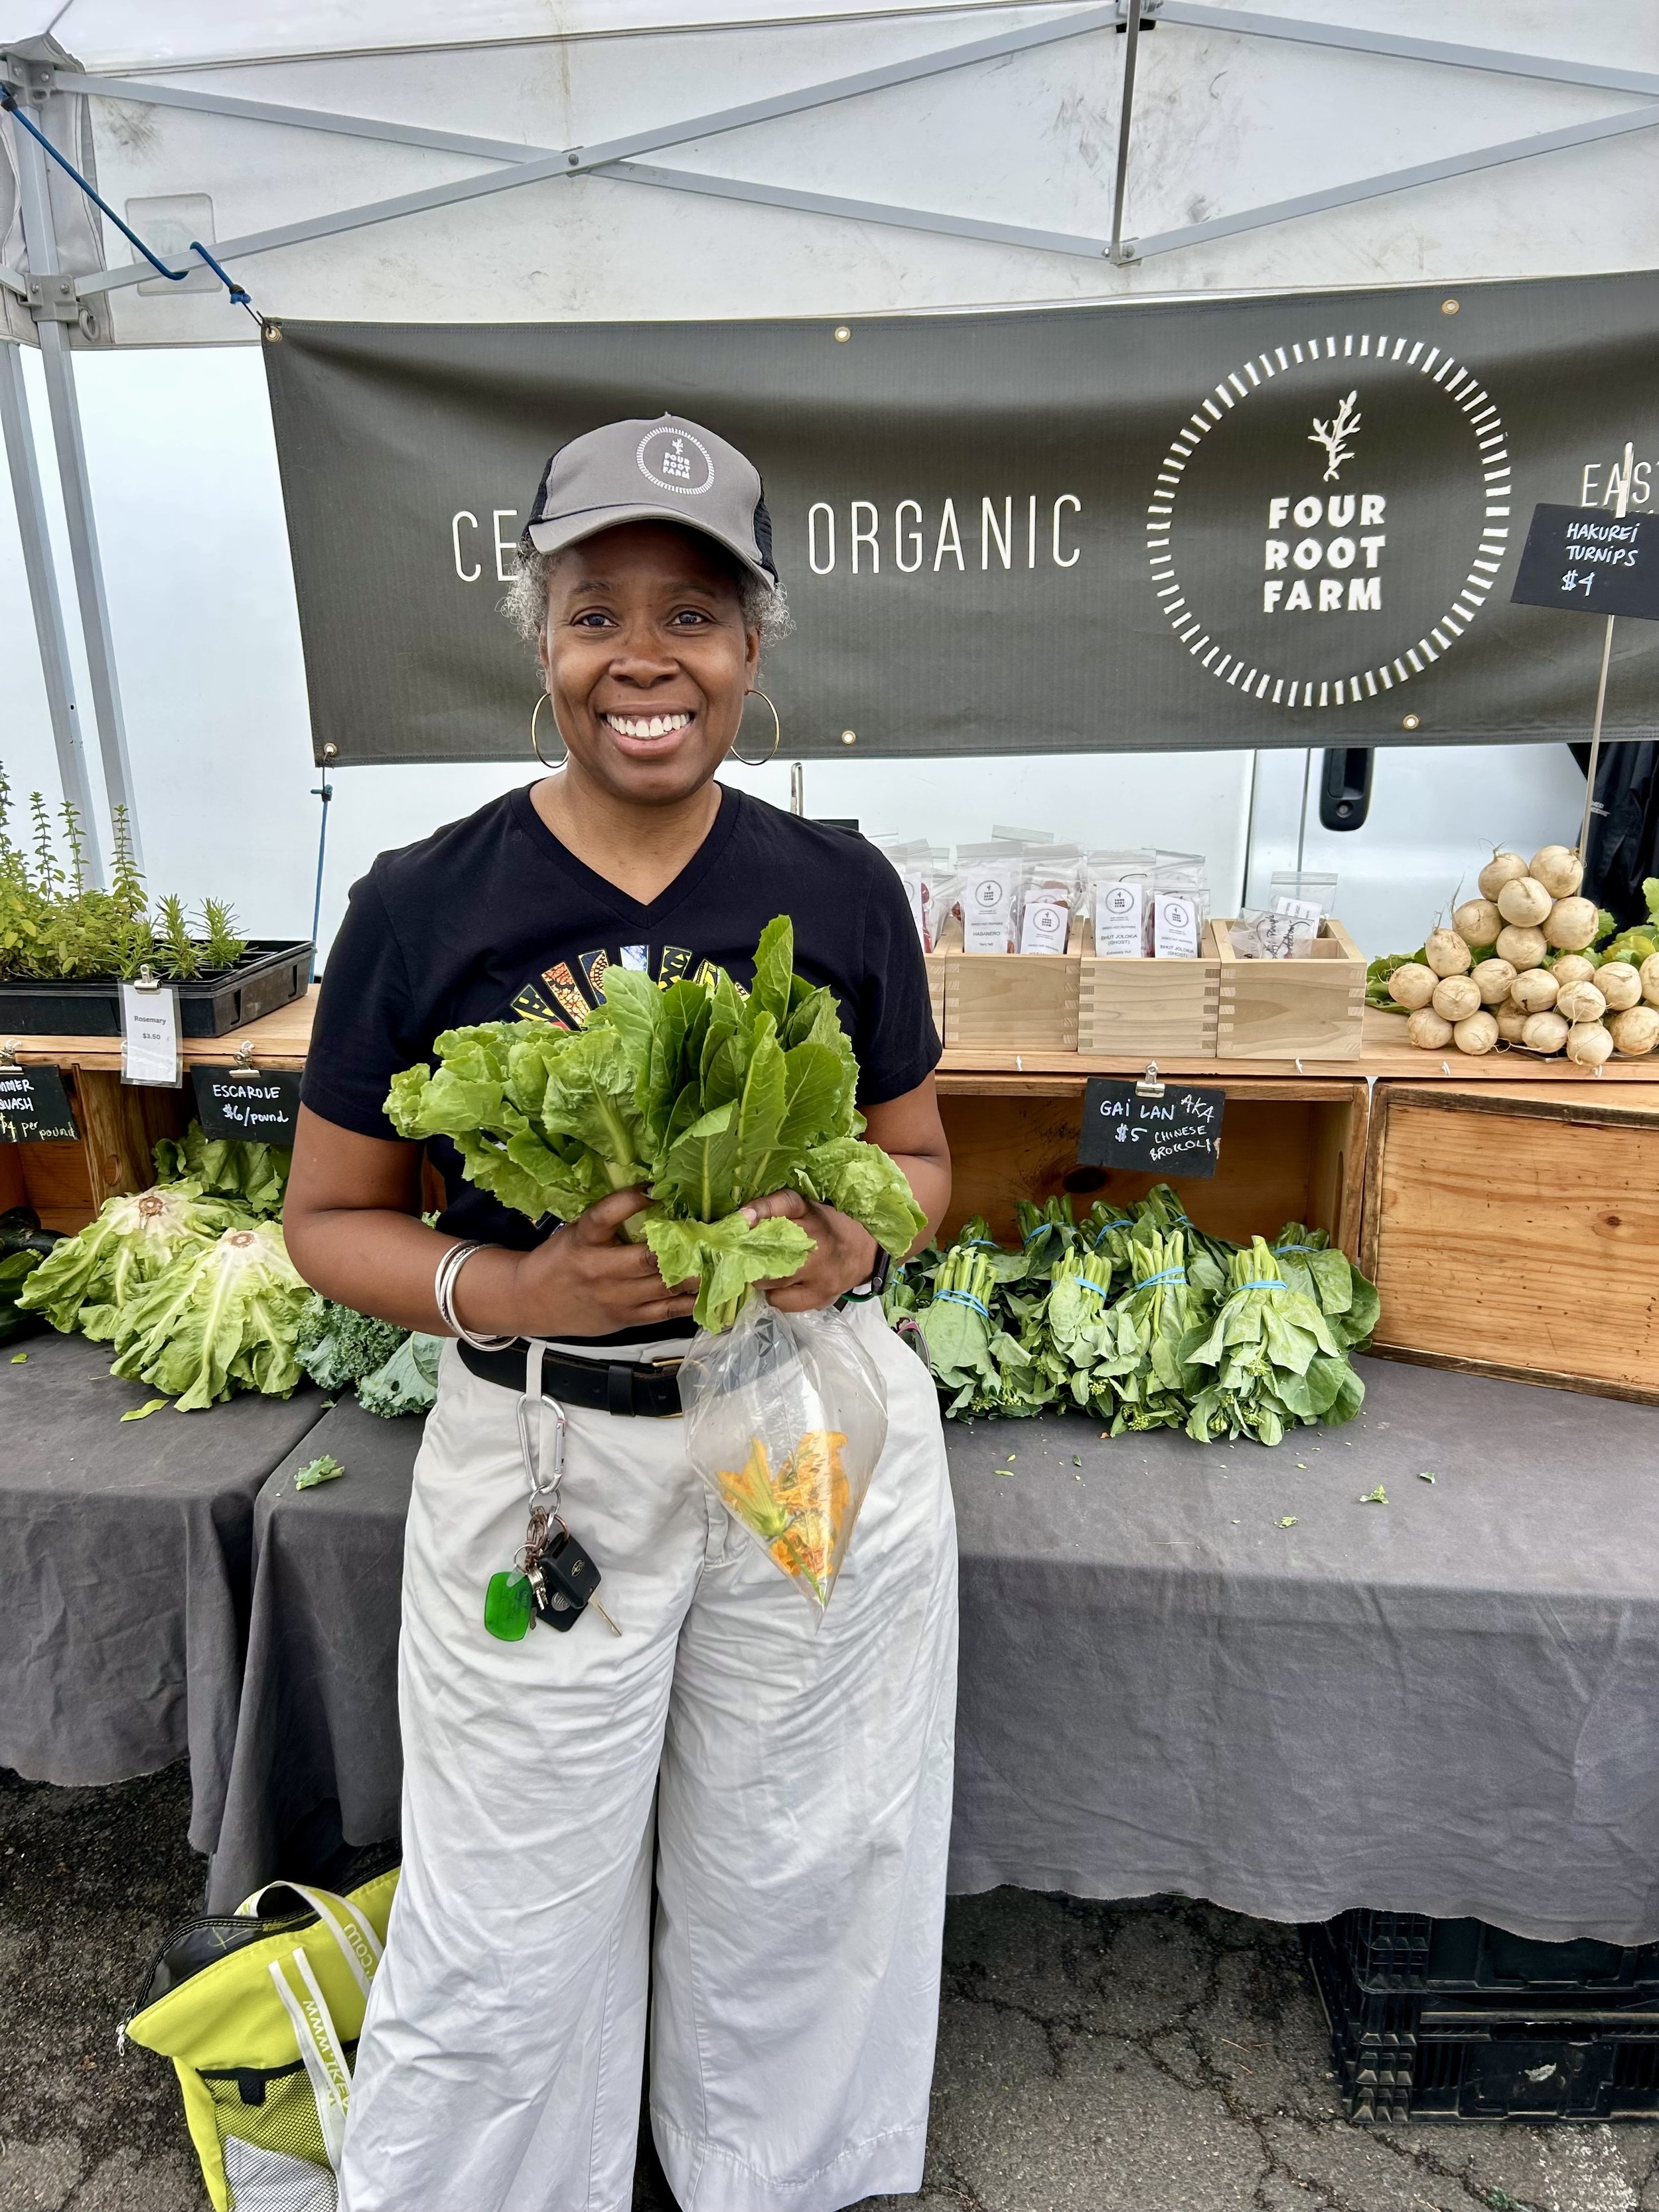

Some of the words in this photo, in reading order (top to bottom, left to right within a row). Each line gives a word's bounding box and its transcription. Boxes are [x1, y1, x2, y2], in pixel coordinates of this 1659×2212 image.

[663, 459, 691, 473] ROOT
[664, 451, 690, 466] FOUR
[662, 466, 690, 480] FARM
[1581, 461, 1659, 507] EAS
[1268, 494, 1386, 530] FOUR
[452, 510, 521, 582] CE
[808, 494, 1082, 575] ORGANIC
[1264, 535, 1386, 571] ROOT
[1561, 569, 1595, 597] $4
[1263, 577, 1382, 613] FARM
[134, 1015, 167, 1025] Rosemary
[0, 1078, 35, 1092] MMER
[212, 1084, 281, 1099] ESCAROLE
[222, 1103, 289, 1127] $6/pound
[1139, 1104, 1175, 1120] LAN
[1181, 1094, 1214, 1123] AKA
[21, 1121, 38, 1138] per
[38, 1122, 78, 1141] pound
[1115, 1123, 1147, 1142] $5
[1154, 1125, 1206, 1143] CHINESE
